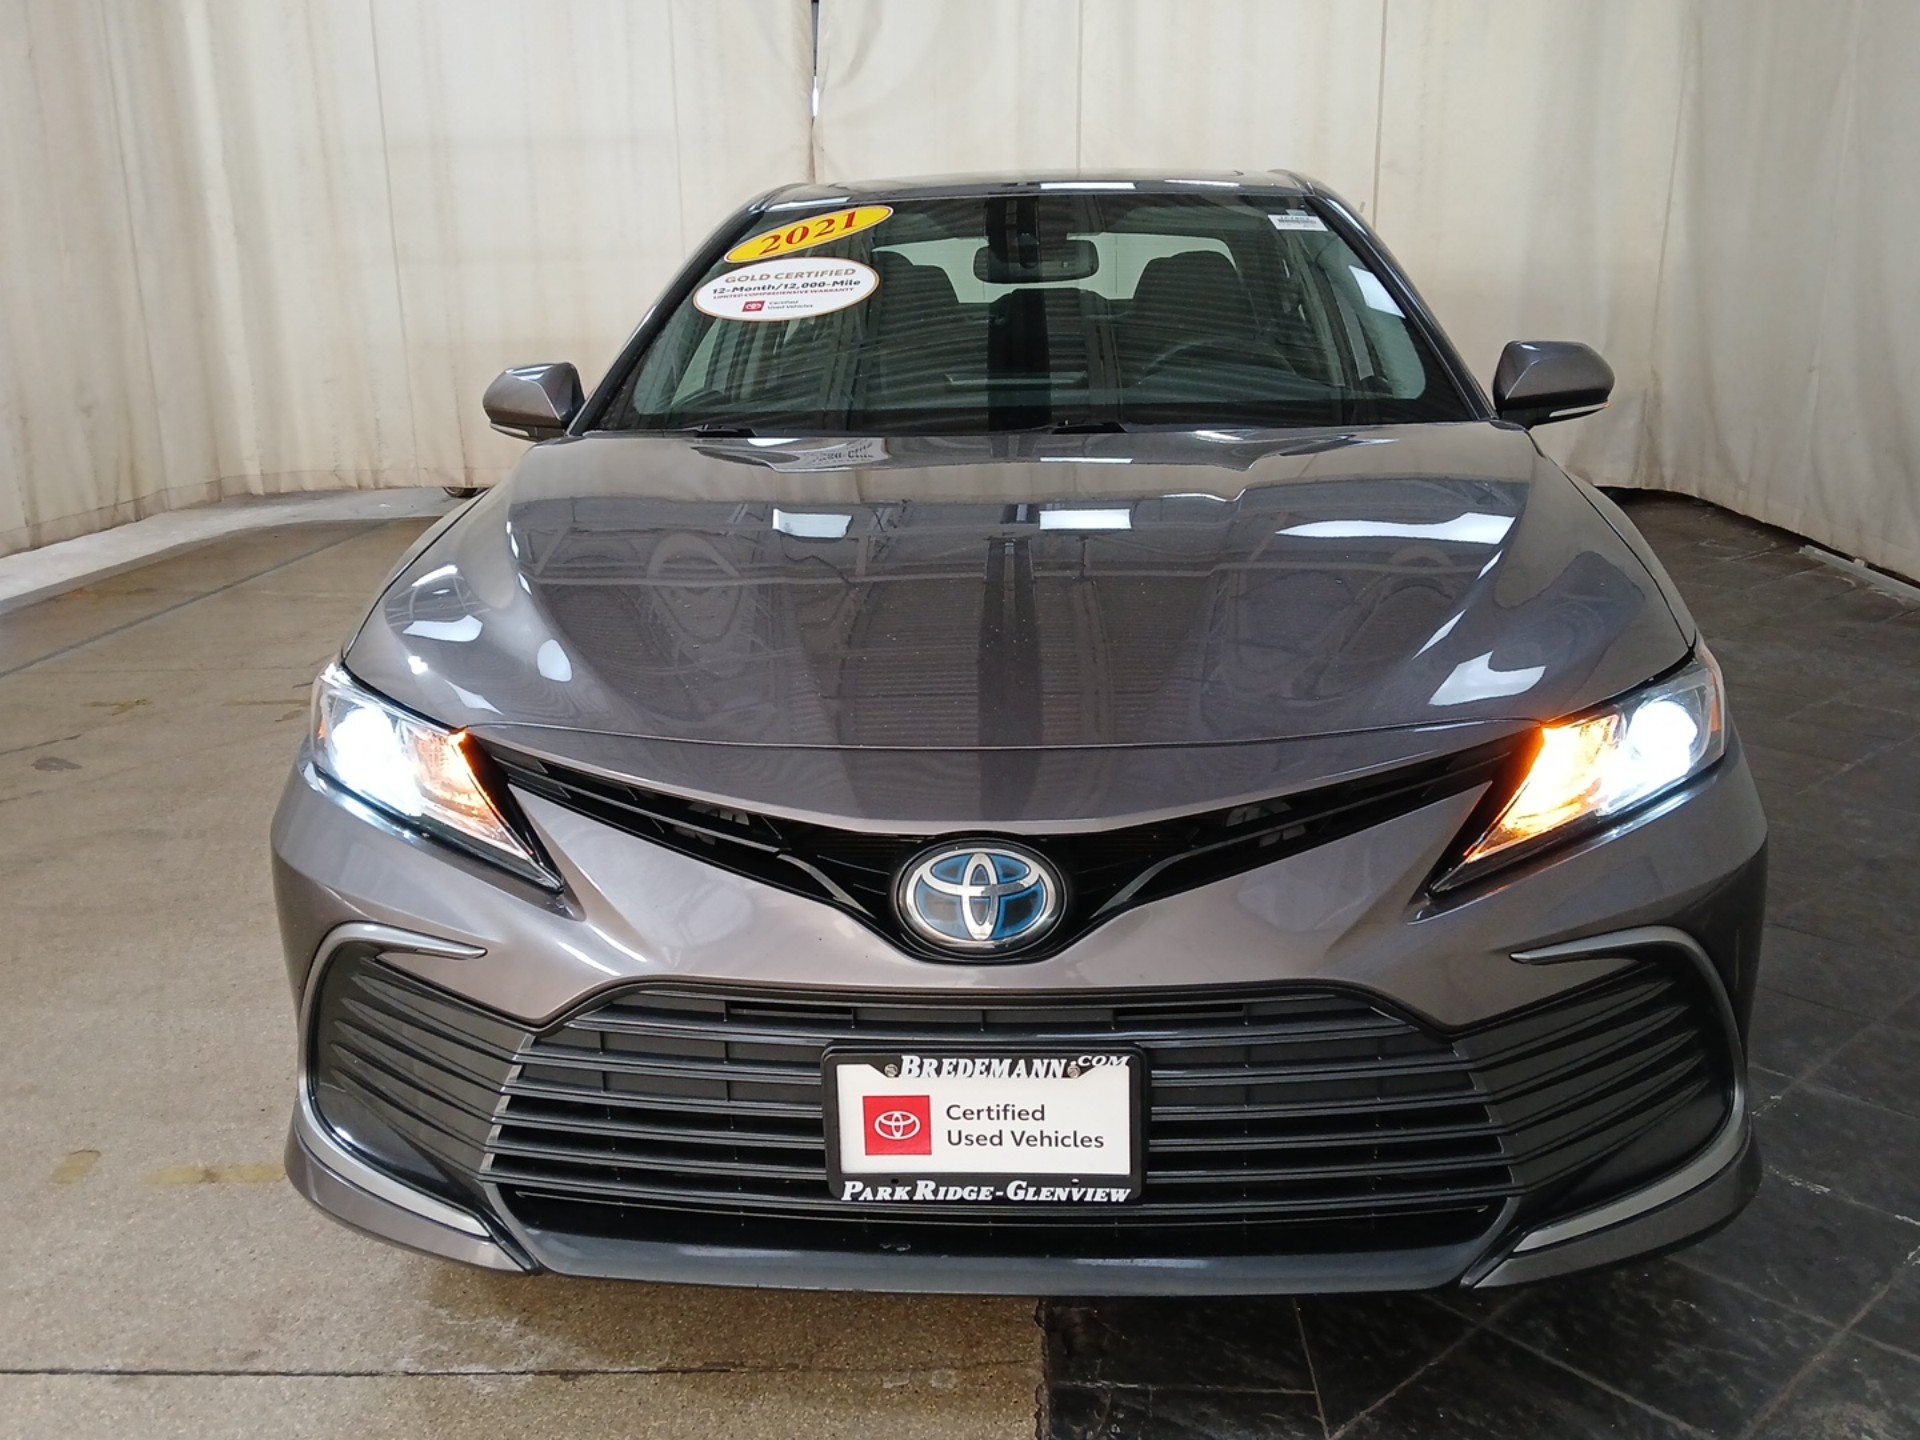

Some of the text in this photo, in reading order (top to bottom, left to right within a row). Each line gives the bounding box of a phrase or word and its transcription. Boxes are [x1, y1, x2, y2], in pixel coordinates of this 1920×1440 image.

[759, 211, 857, 255] 2021
[725, 268, 856, 283] GOLD CERTIFIED
[712, 279, 861, 294] 12-Month/12,000-Mile
[946, 1103, 1046, 1121] Certified
[947, 1129, 1105, 1148] Used Vehicles
[841, 1180, 1131, 1203] PARK RIDGE-GLENVIEW
